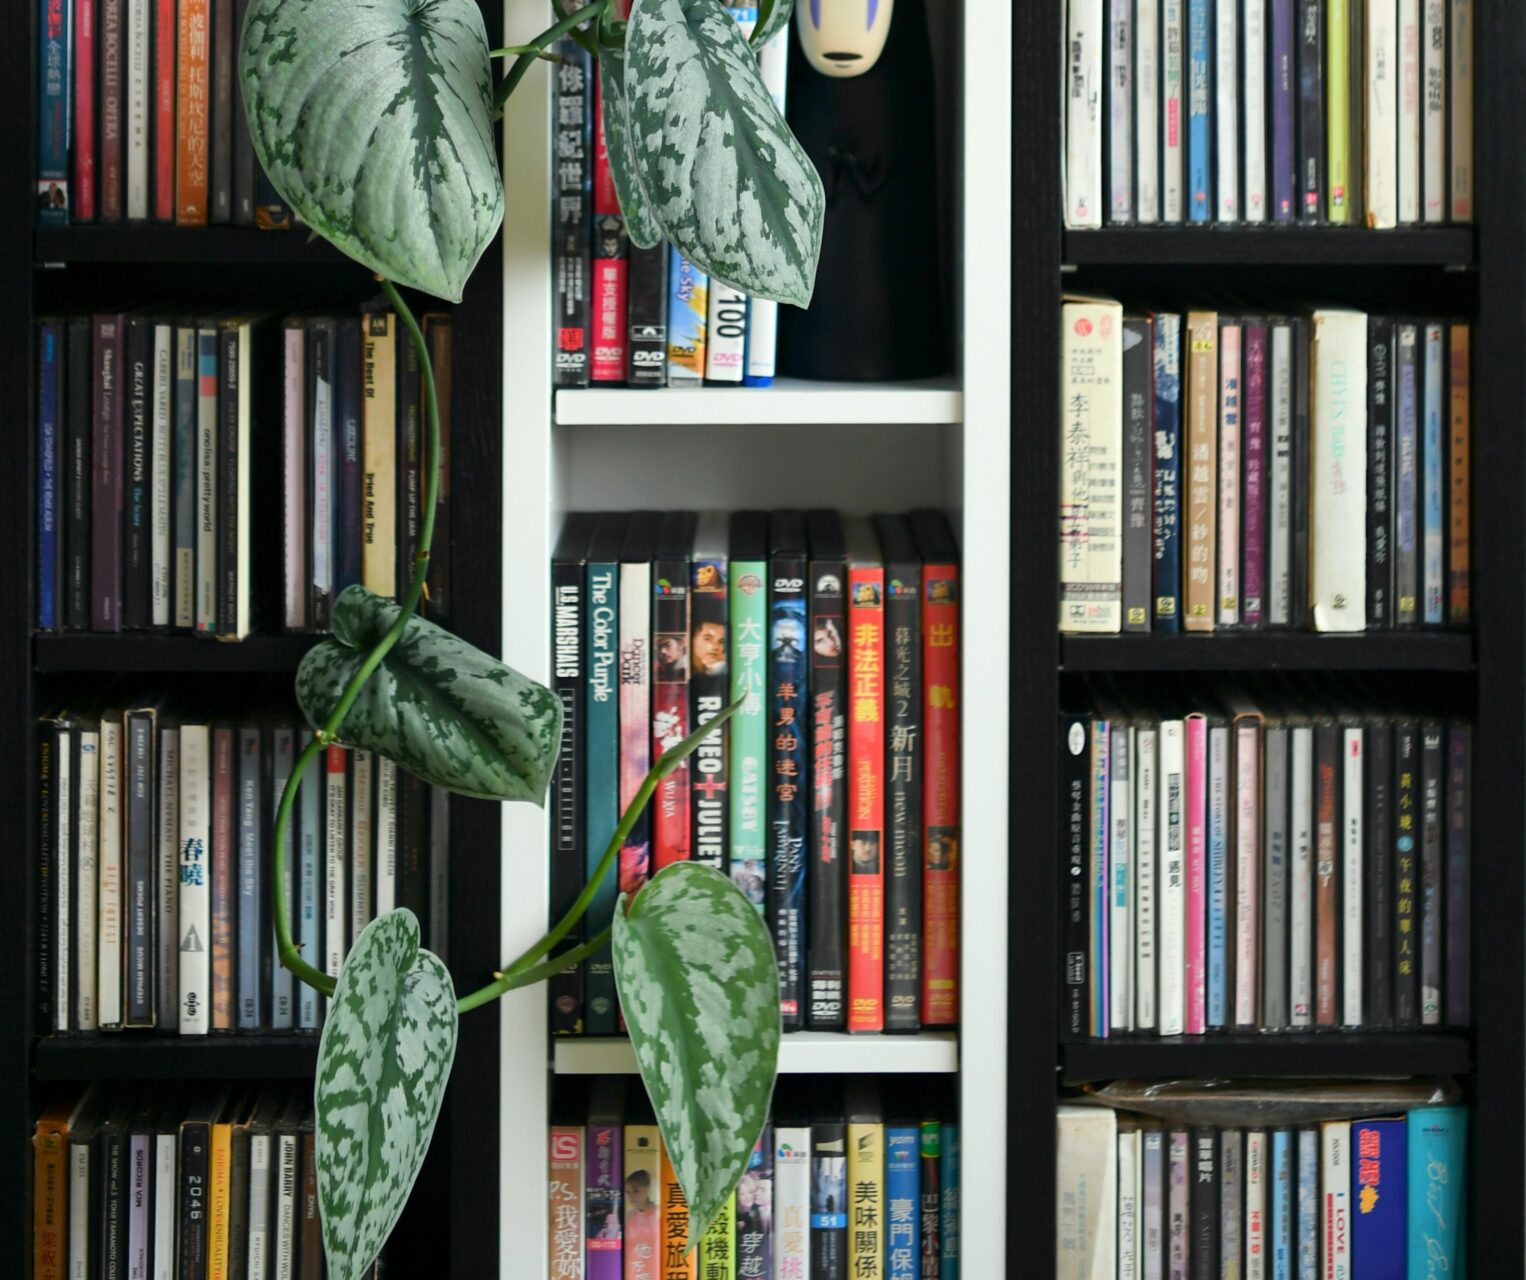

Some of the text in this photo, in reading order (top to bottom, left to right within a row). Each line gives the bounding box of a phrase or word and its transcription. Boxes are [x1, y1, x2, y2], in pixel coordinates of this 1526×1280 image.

[105, 32, 118, 87] BOCELLI
[135, 31, 143, 71] BOCELLI
[105, 97, 118, 139] OPERA
[677, 274, 693, 301] Sky
[716, 294, 745, 339] 100
[103, 348, 112, 390] Shanghai
[132, 361, 144, 396] GREAT
[365, 341, 375, 399] The Best Of
[132, 399, 144, 482] EXPECTATIONS
[407, 469, 416, 490] PUMP
[365, 472, 375, 544] Tried And True
[555, 606, 580, 678] MARSHALS
[590, 572, 614, 703] The Color Purple
[854, 623, 880, 723] 非法正義
[41, 742, 49, 781] ENIGMA
[775, 682, 799, 802] 羊男的迷宮
[243, 779, 253, 800] Ken
[165, 750, 174, 914] MICHAEL NYMAN THE PIANO
[243, 801, 253, 826] Yang
[243, 859, 253, 875] the
[243, 877, 253, 896] Sky
[136, 880, 145, 1004] STEPHAN MICUS DESERT POEMS
[216, 1148, 225, 1185] ENIGMA
[284, 1140, 294, 1166] JOHN
[136, 1149, 144, 1208] MCA RECORDS
[188, 1175, 203, 1220] 2046
[283, 1167, 293, 1197] BARRY
[109, 1220, 118, 1260] YAMAMOTO
[282, 1204, 292, 1238] DANCES
[854, 1181, 879, 1278] 美味關係
[1336, 1207, 1346, 1255] LOVE
